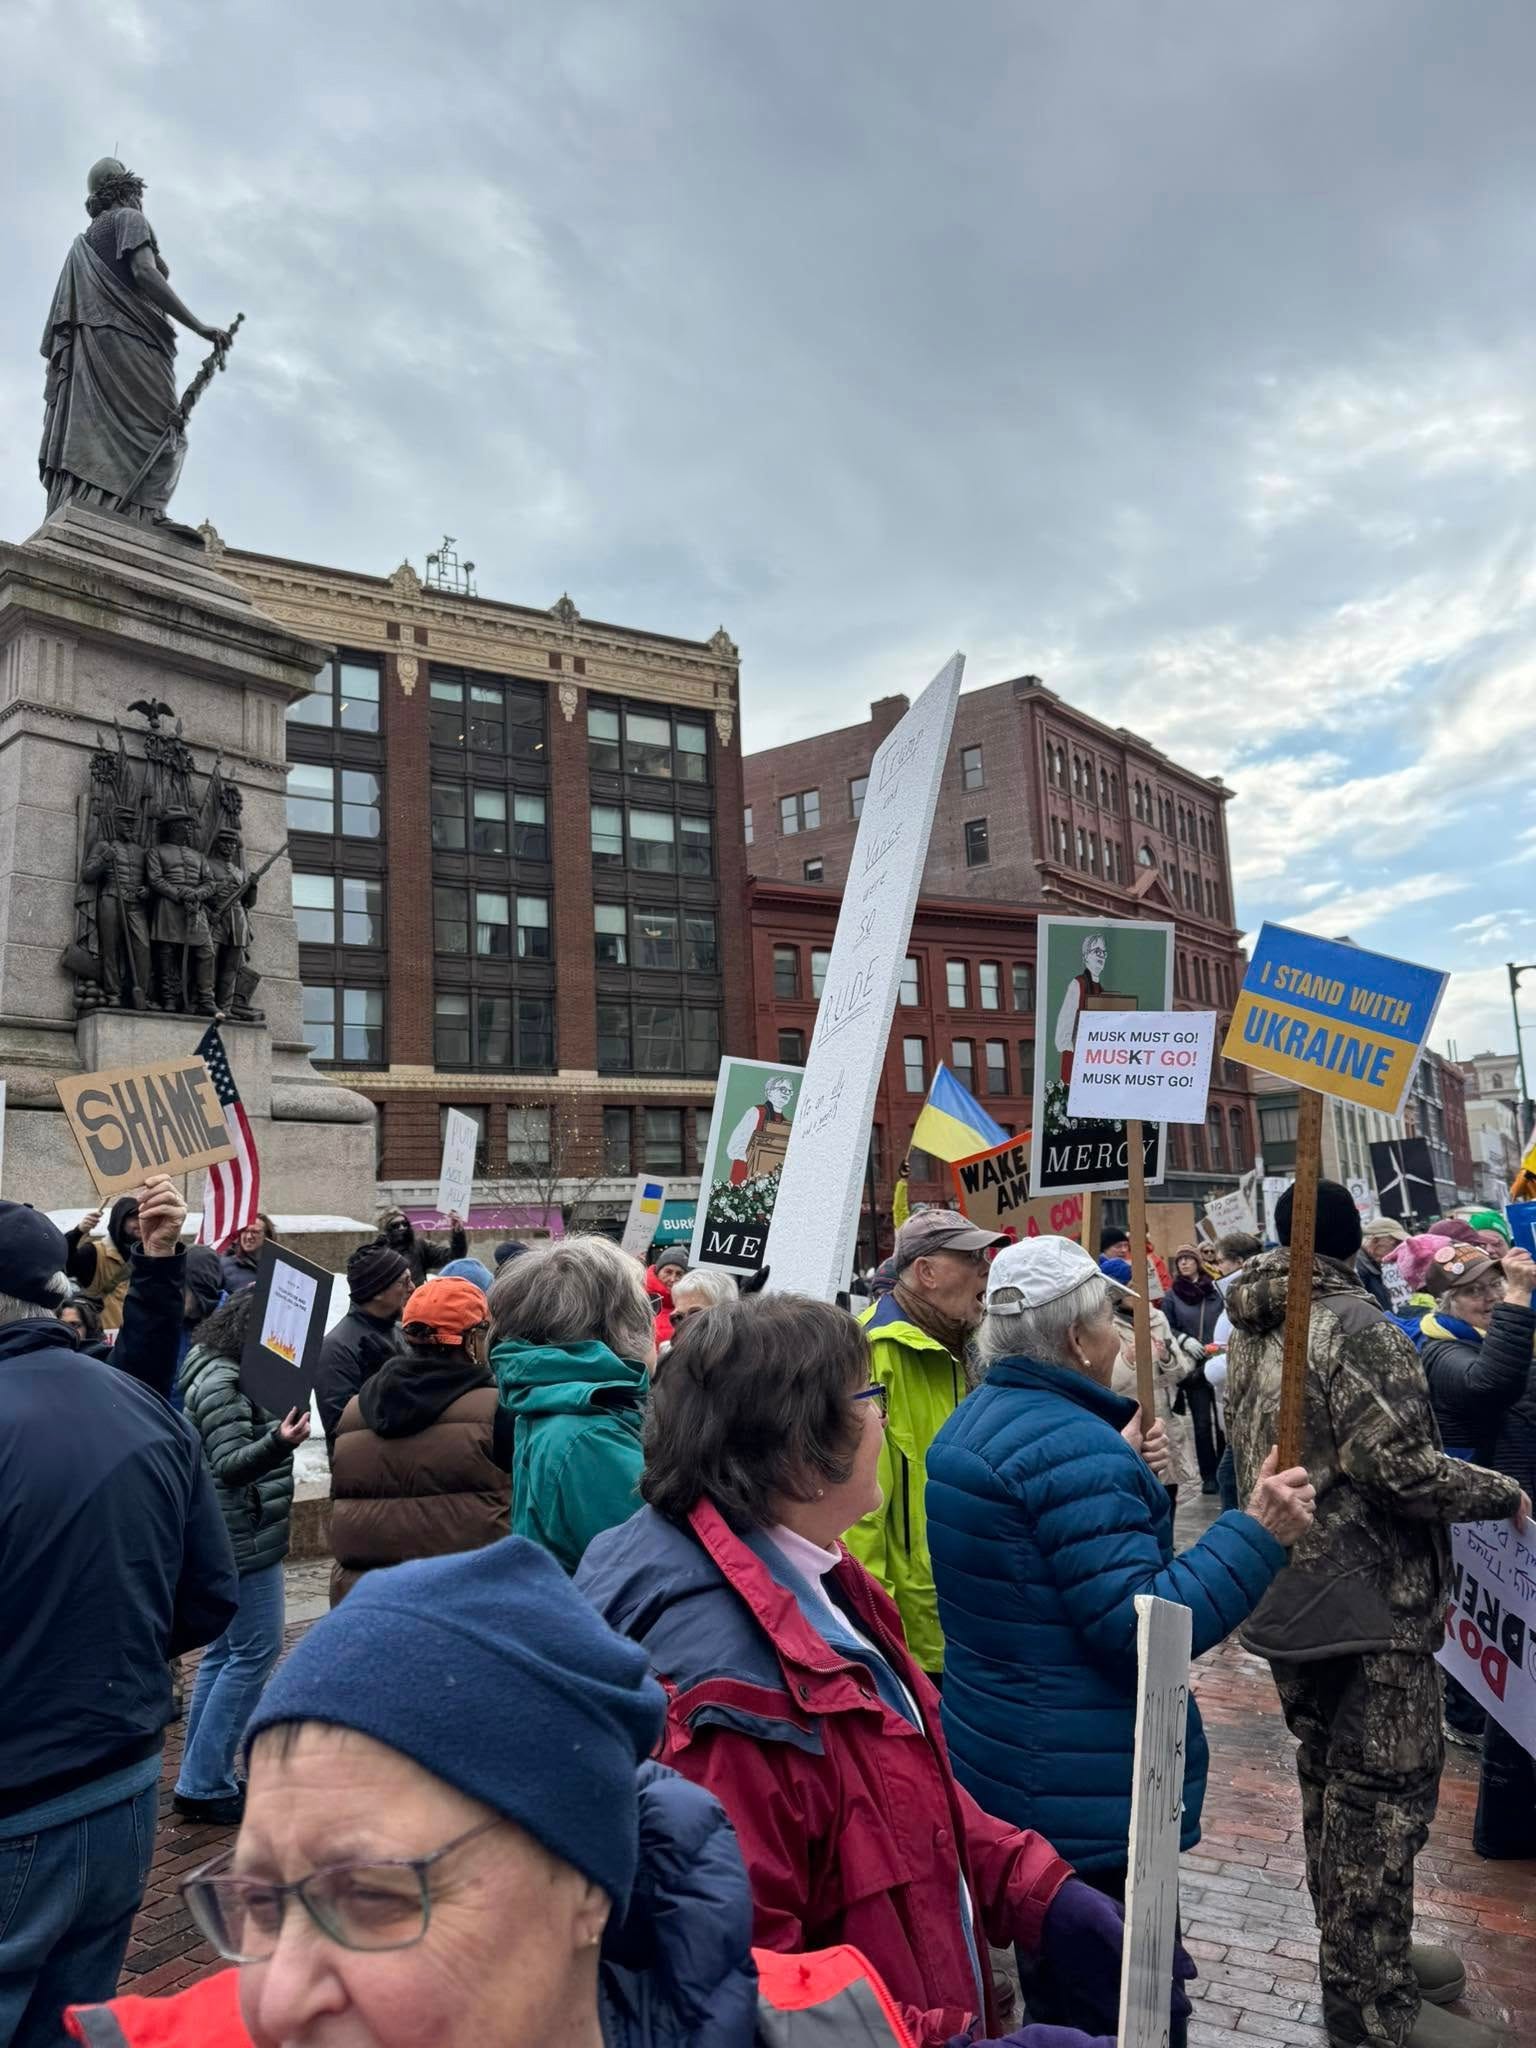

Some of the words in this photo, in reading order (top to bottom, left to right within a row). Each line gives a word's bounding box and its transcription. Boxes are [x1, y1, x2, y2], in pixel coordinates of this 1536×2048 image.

[865, 822, 903, 870] Vance
[818, 956, 879, 1044] RUDE
[1260, 960, 1271, 984] I
[1274, 965, 1345, 1006] STAND
[1350, 986, 1412, 1026] WITH
[1085, 1049, 1155, 1065] MUSKT
[1160, 1051, 1198, 1066] GO!
[1088, 1031, 1126, 1042] MUSK
[1130, 1032, 1170, 1043] MUST
[1173, 1032, 1199, 1044] GO!
[1243, 1005, 1395, 1087] UKRAINE
[1082, 1073, 1121, 1085] MUSK
[1125, 1074, 1164, 1086] MUST
[1168, 1076, 1193, 1087] GO!
[76, 1066, 231, 1177] SHAME
[960, 1145, 1028, 1194] WAKE
[1045, 1139, 1155, 1173] MERCY
[1468, 1534, 1505, 1584] Thug
[1135, 1684, 1187, 1886] SHAME
